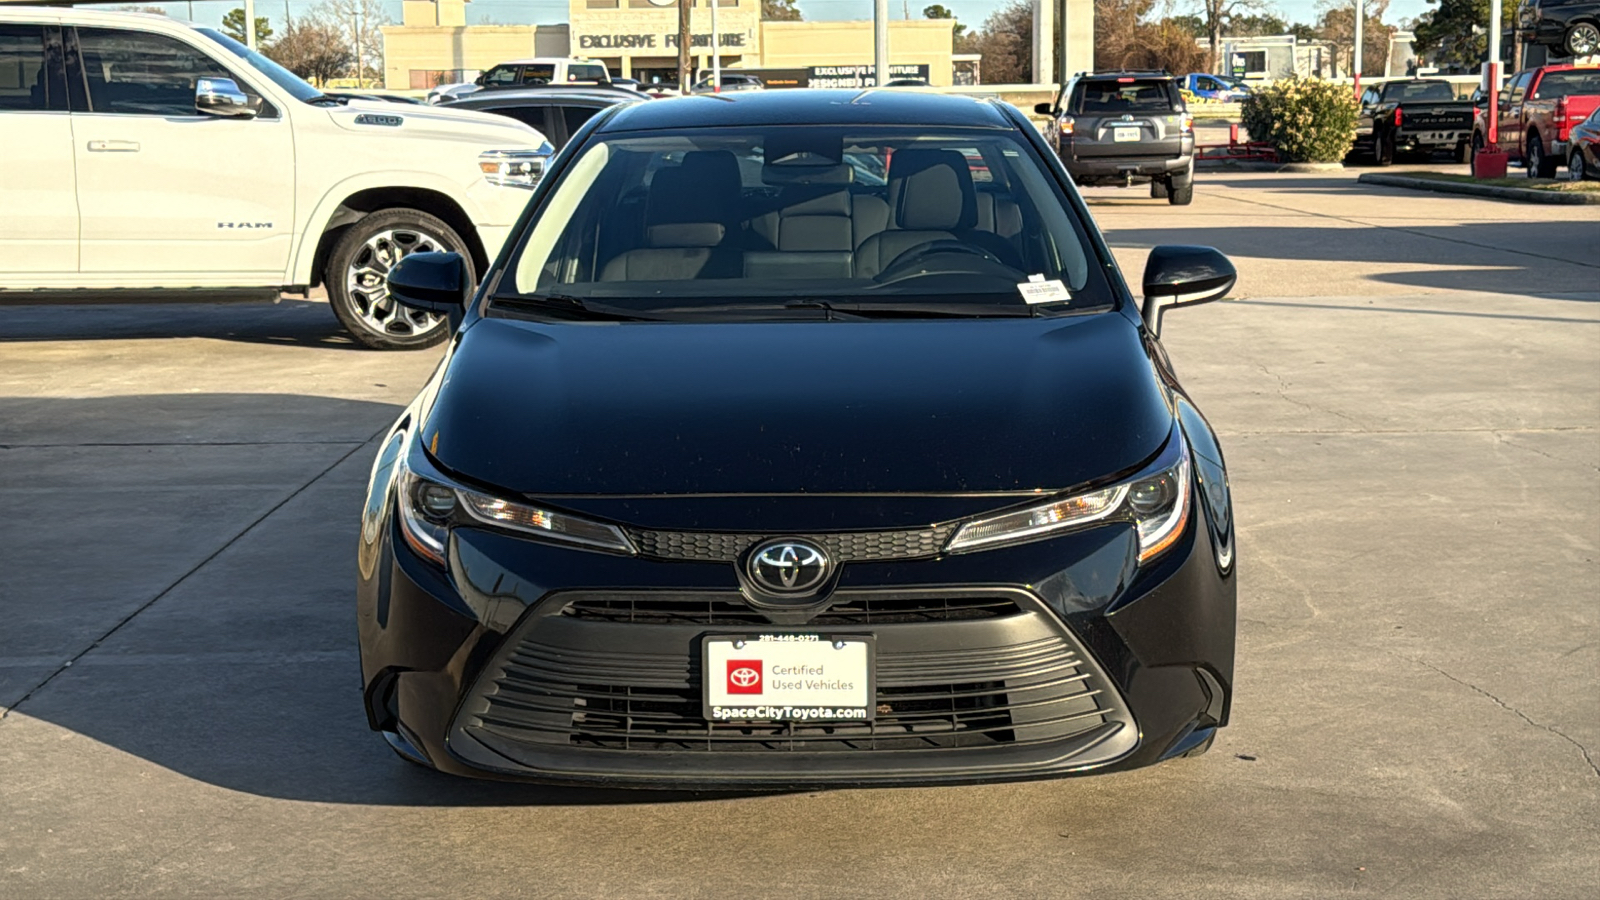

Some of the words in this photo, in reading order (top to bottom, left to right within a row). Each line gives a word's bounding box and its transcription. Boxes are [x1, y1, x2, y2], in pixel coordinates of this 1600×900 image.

[579, 34, 656, 48] EXCLUSIVE
[665, 33, 746, 47] FUNITURE
[814, 66, 867, 75] EXCLUSIVE
[772, 665, 824, 676] Certified
[772, 680, 802, 690] Used
[805, 680, 854, 690] Vehicles
[713, 706, 867, 719] SpaceCityToyota.com
